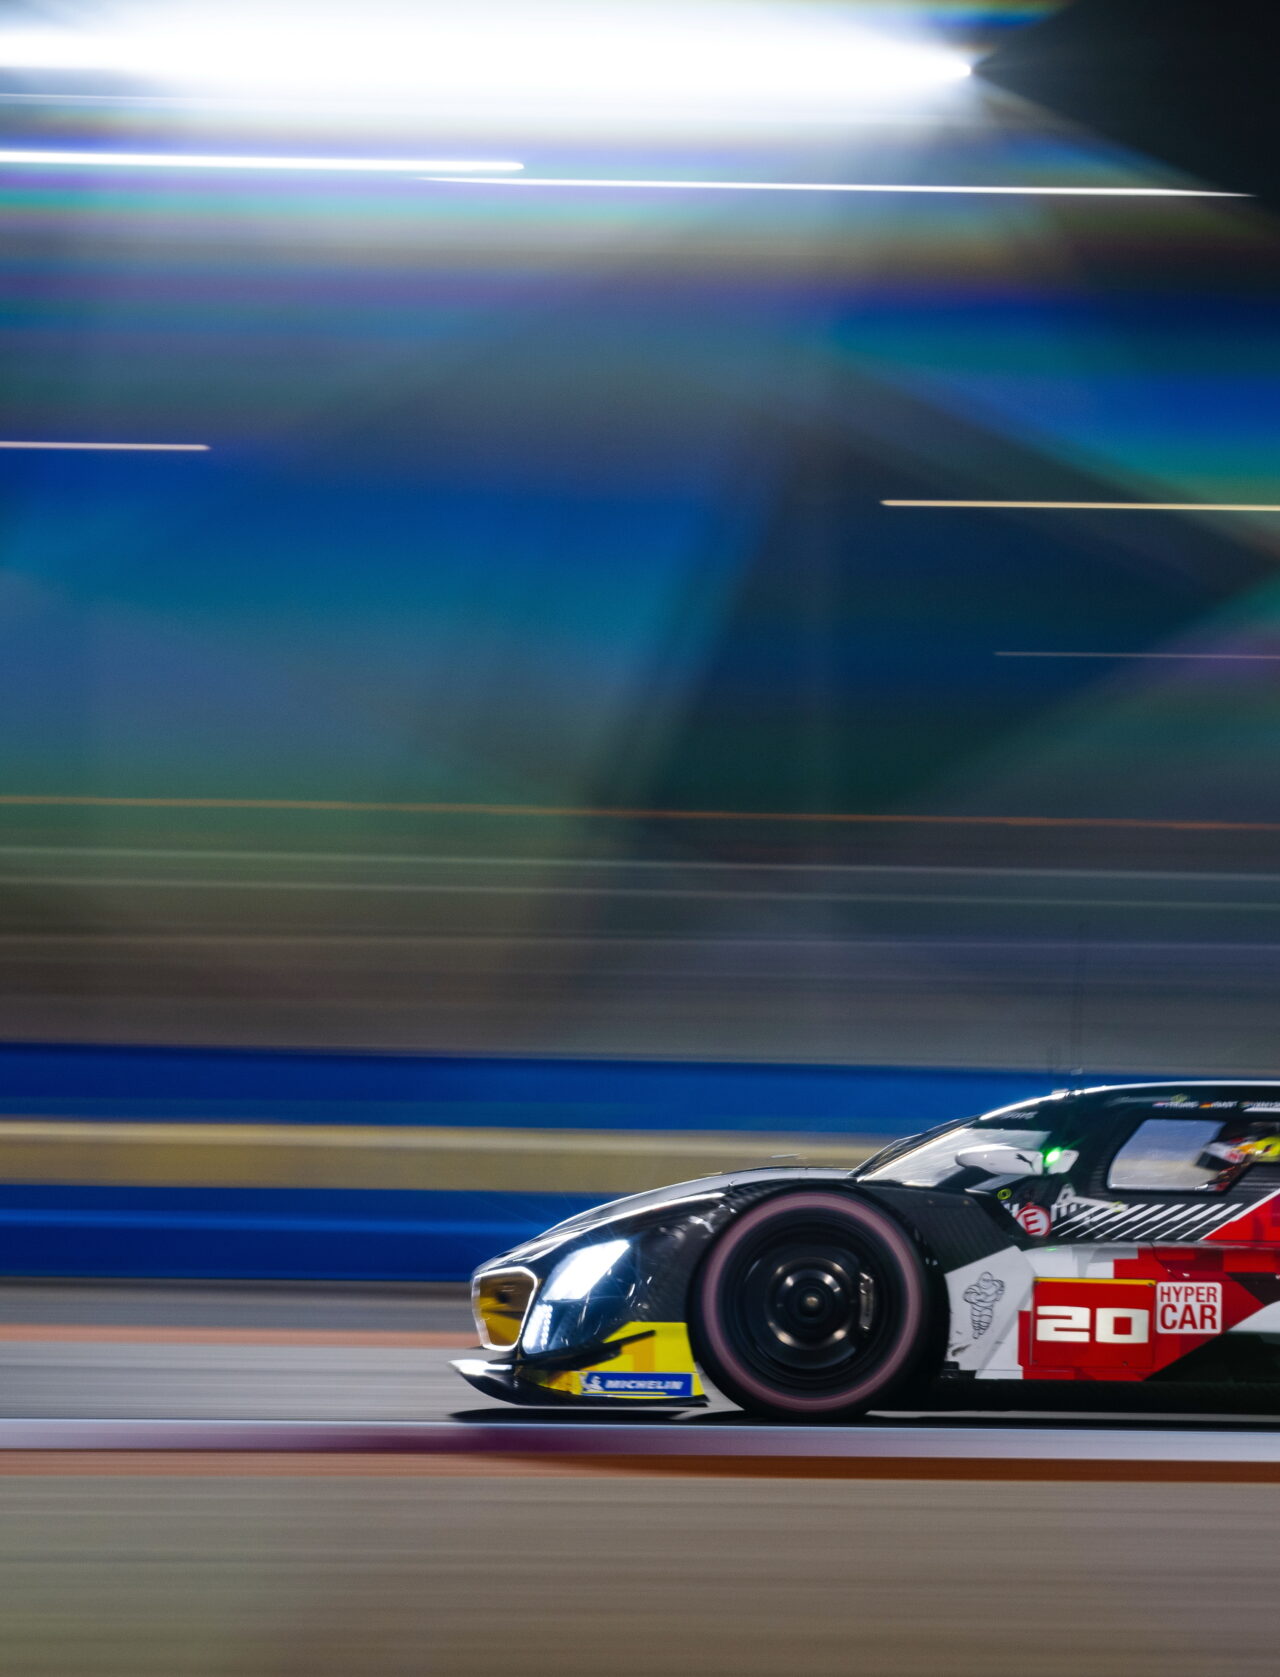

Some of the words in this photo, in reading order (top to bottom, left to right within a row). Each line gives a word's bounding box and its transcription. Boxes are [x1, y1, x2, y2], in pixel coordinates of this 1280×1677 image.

[1160, 1286, 1217, 1303] HYPER
[1036, 1305, 1149, 1344] 20
[1160, 1304, 1217, 1330] CAR
[604, 1380, 684, 1390] MICHELIN
